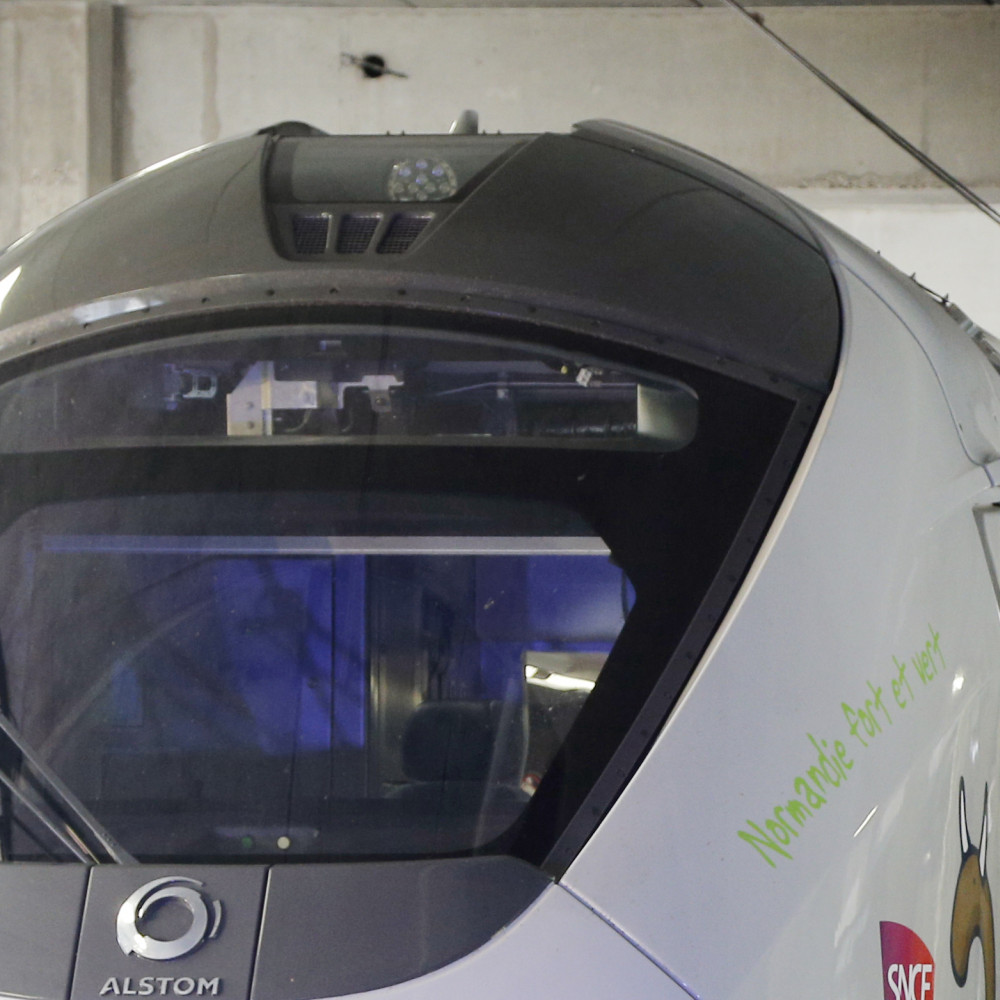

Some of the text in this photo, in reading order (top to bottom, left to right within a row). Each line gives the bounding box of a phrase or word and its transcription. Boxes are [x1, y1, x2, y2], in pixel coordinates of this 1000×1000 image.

[737, 622, 946, 868] Normandie fort et vert
[99, 976, 220, 997] ALSTOM
